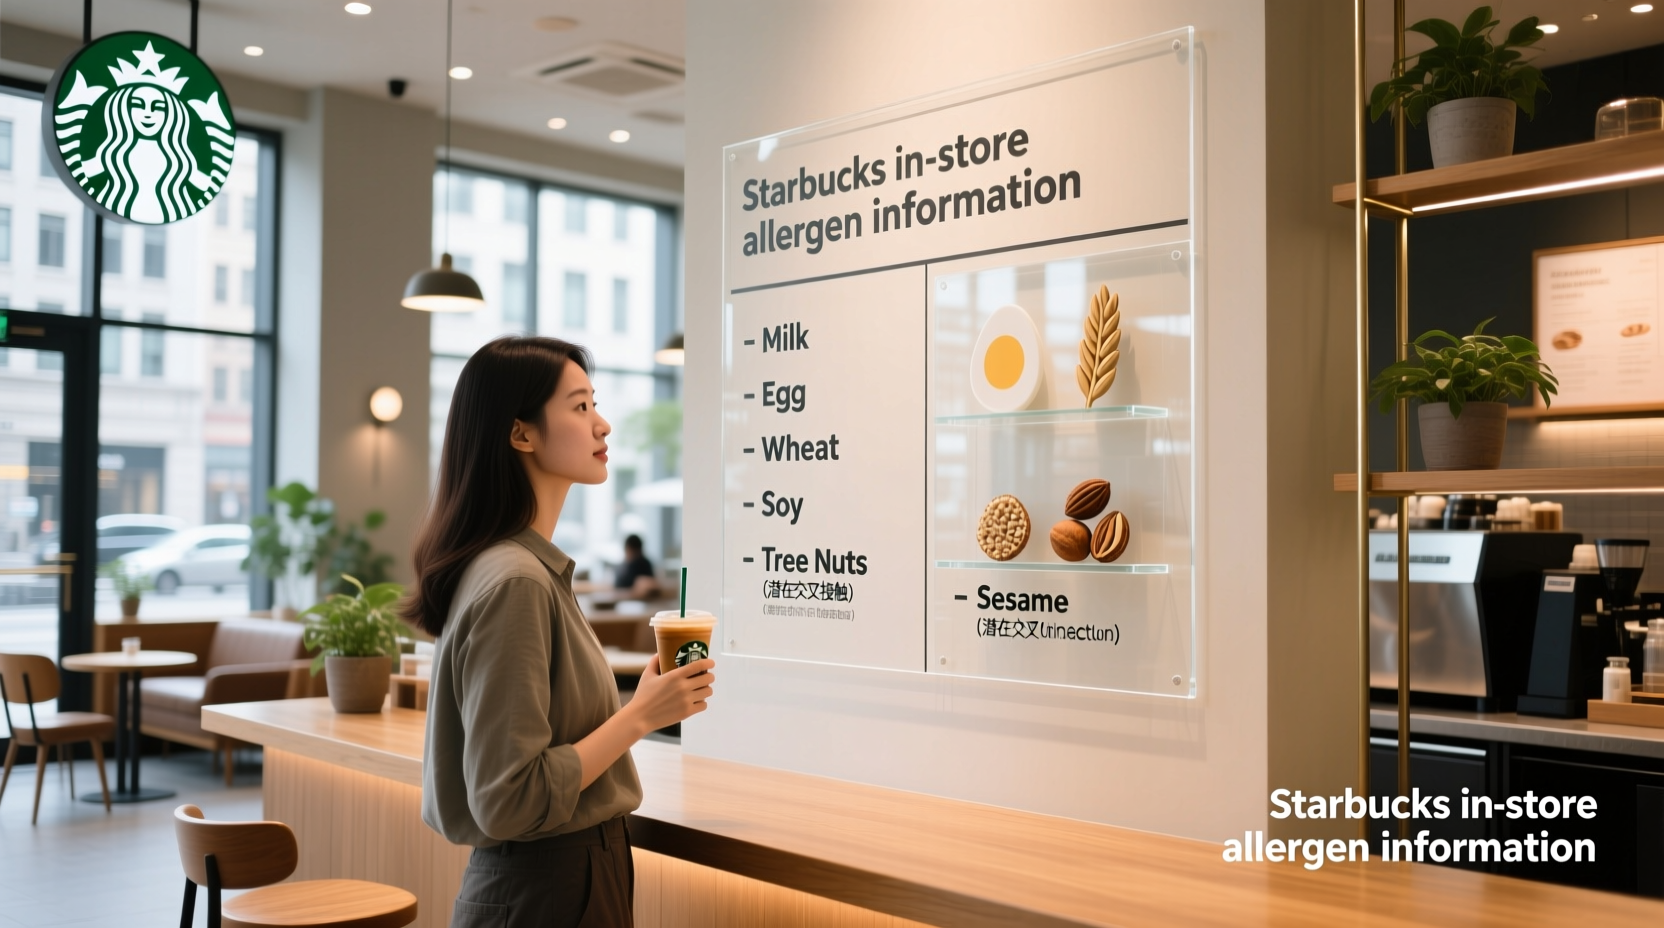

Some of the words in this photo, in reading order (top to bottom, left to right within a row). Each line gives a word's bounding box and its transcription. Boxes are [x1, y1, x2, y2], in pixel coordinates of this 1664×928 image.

[743, 155, 886, 212] Starbucks
[895, 128, 1029, 181] in-store
[743, 212, 862, 257] allergen
[873, 168, 1081, 234] information
[762, 321, 810, 353] Milk
[762, 380, 806, 414] Egg
[761, 433, 840, 462] Wheat
[761, 490, 804, 525] Soy
[761, 546, 809, 573] Tree
[814, 548, 868, 576] Nuts
[976, 584, 1069, 614] Sesame
